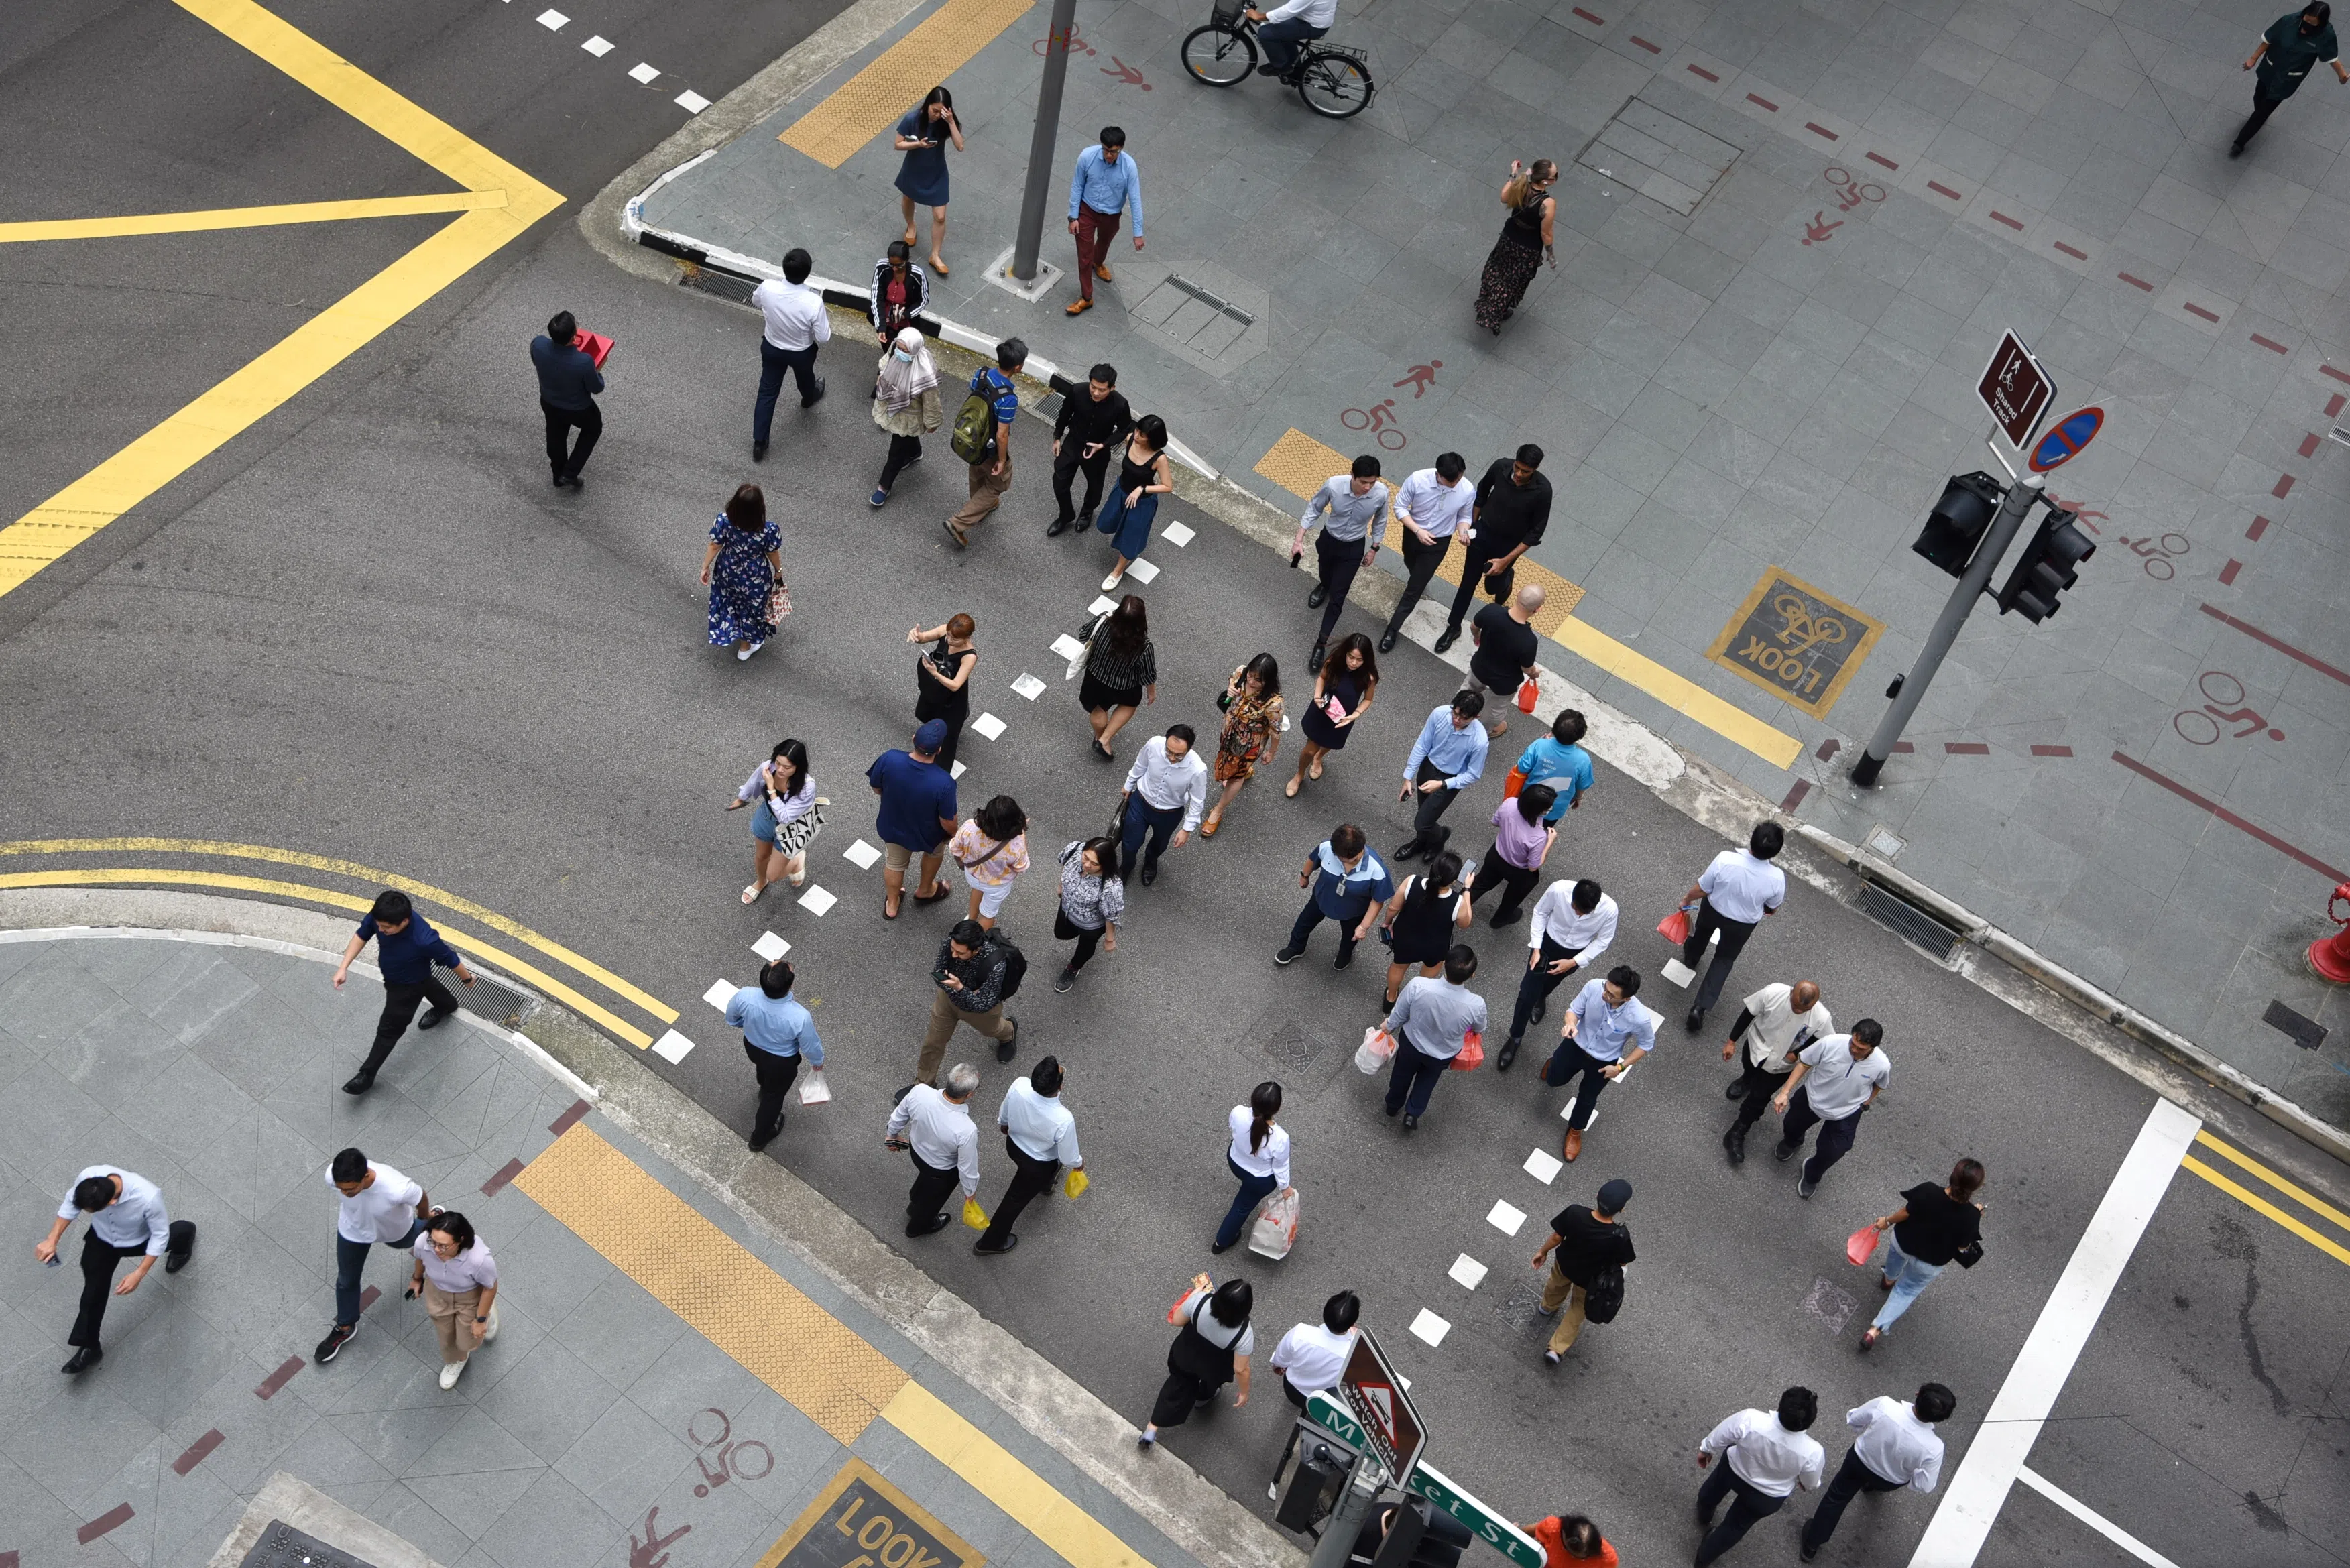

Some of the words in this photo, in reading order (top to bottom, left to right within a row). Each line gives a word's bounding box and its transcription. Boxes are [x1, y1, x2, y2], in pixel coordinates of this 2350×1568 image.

[1993, 398, 2010, 426] Track
[1995, 387, 2018, 420] Shared
[1738, 635, 1822, 694] LOOK
[1345, 1388, 1360, 1412] For
[1362, 1413, 1396, 1475] Vehicles
[1352, 1382, 1378, 1429] Watch
[1380, 1435, 1397, 1463] Out
[1325, 1410, 1464, 1516] Mket
[1480, 1522, 1521, 1558] St
